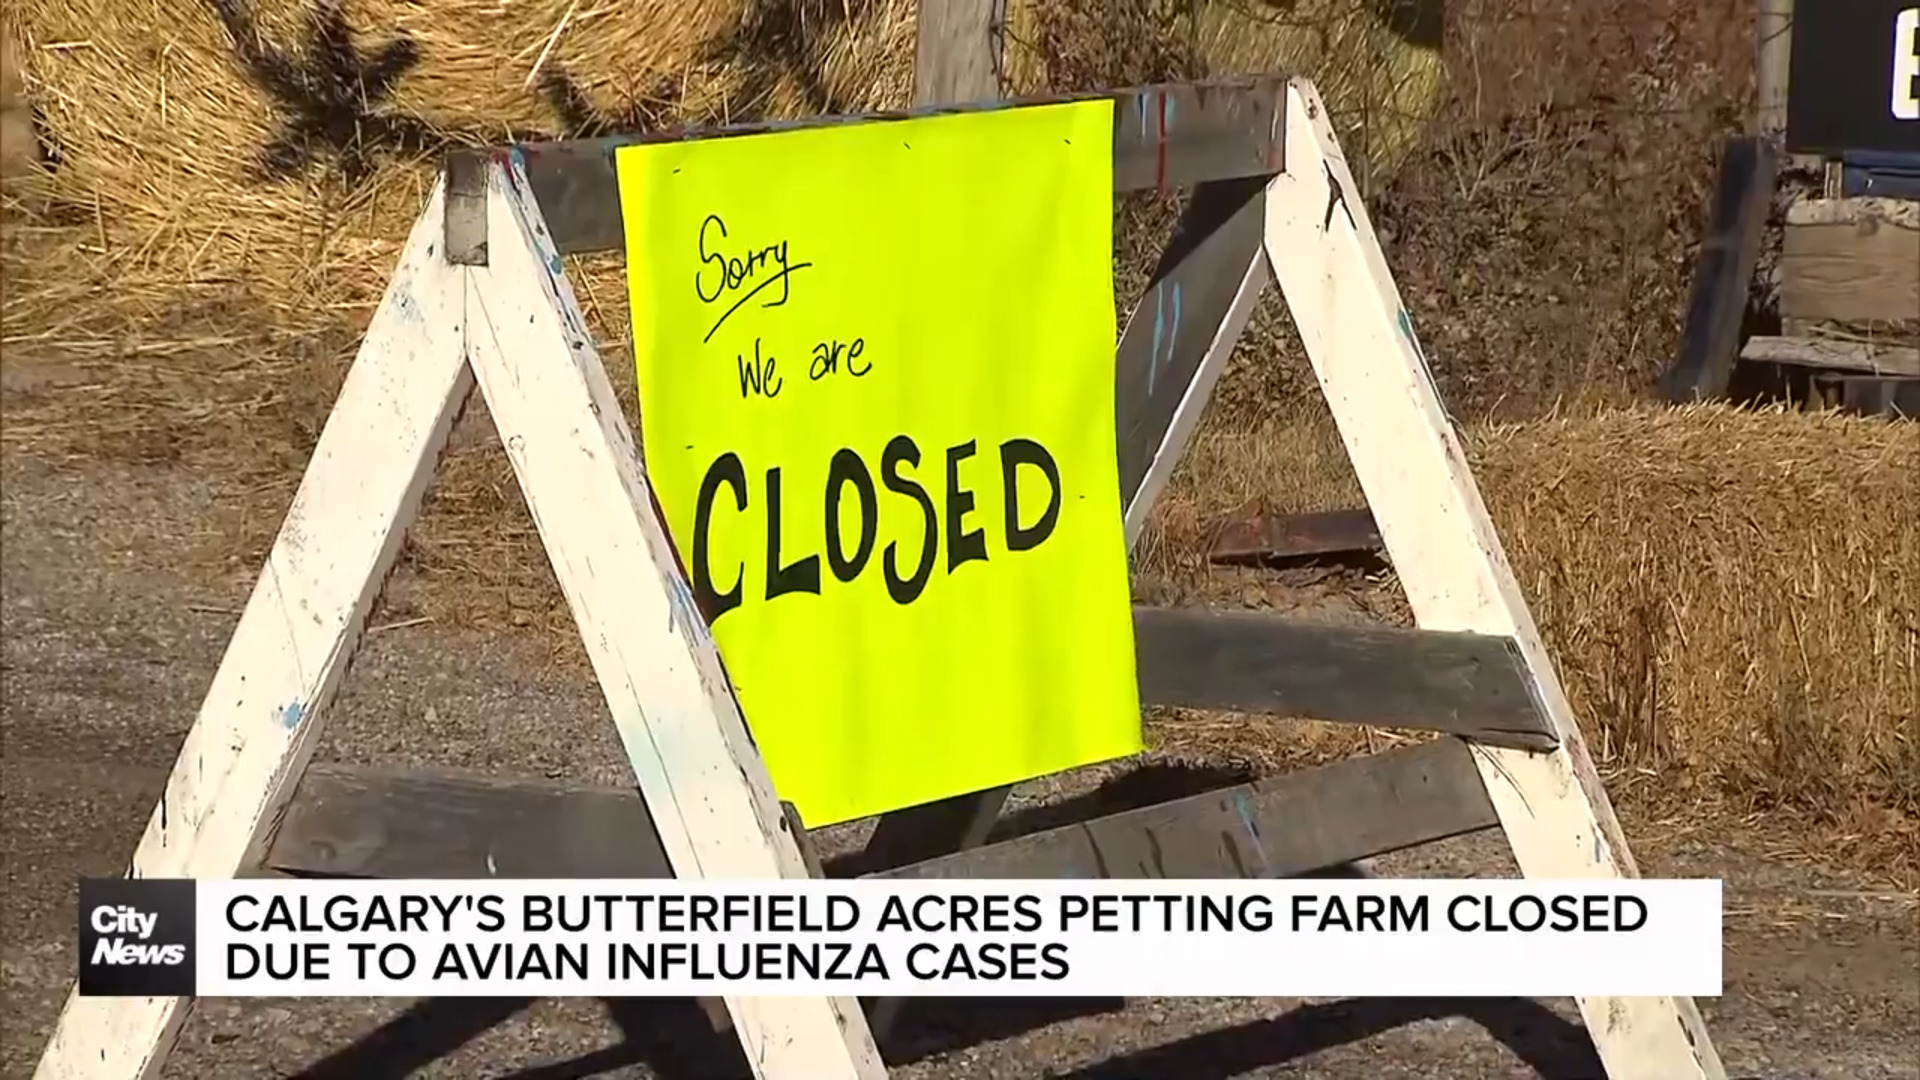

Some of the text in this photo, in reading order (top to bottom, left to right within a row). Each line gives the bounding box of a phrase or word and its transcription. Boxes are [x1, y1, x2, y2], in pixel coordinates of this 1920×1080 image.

[696, 215, 812, 308] Sorry
[738, 338, 872, 398] We are
[692, 435, 1061, 620] CLOSED
